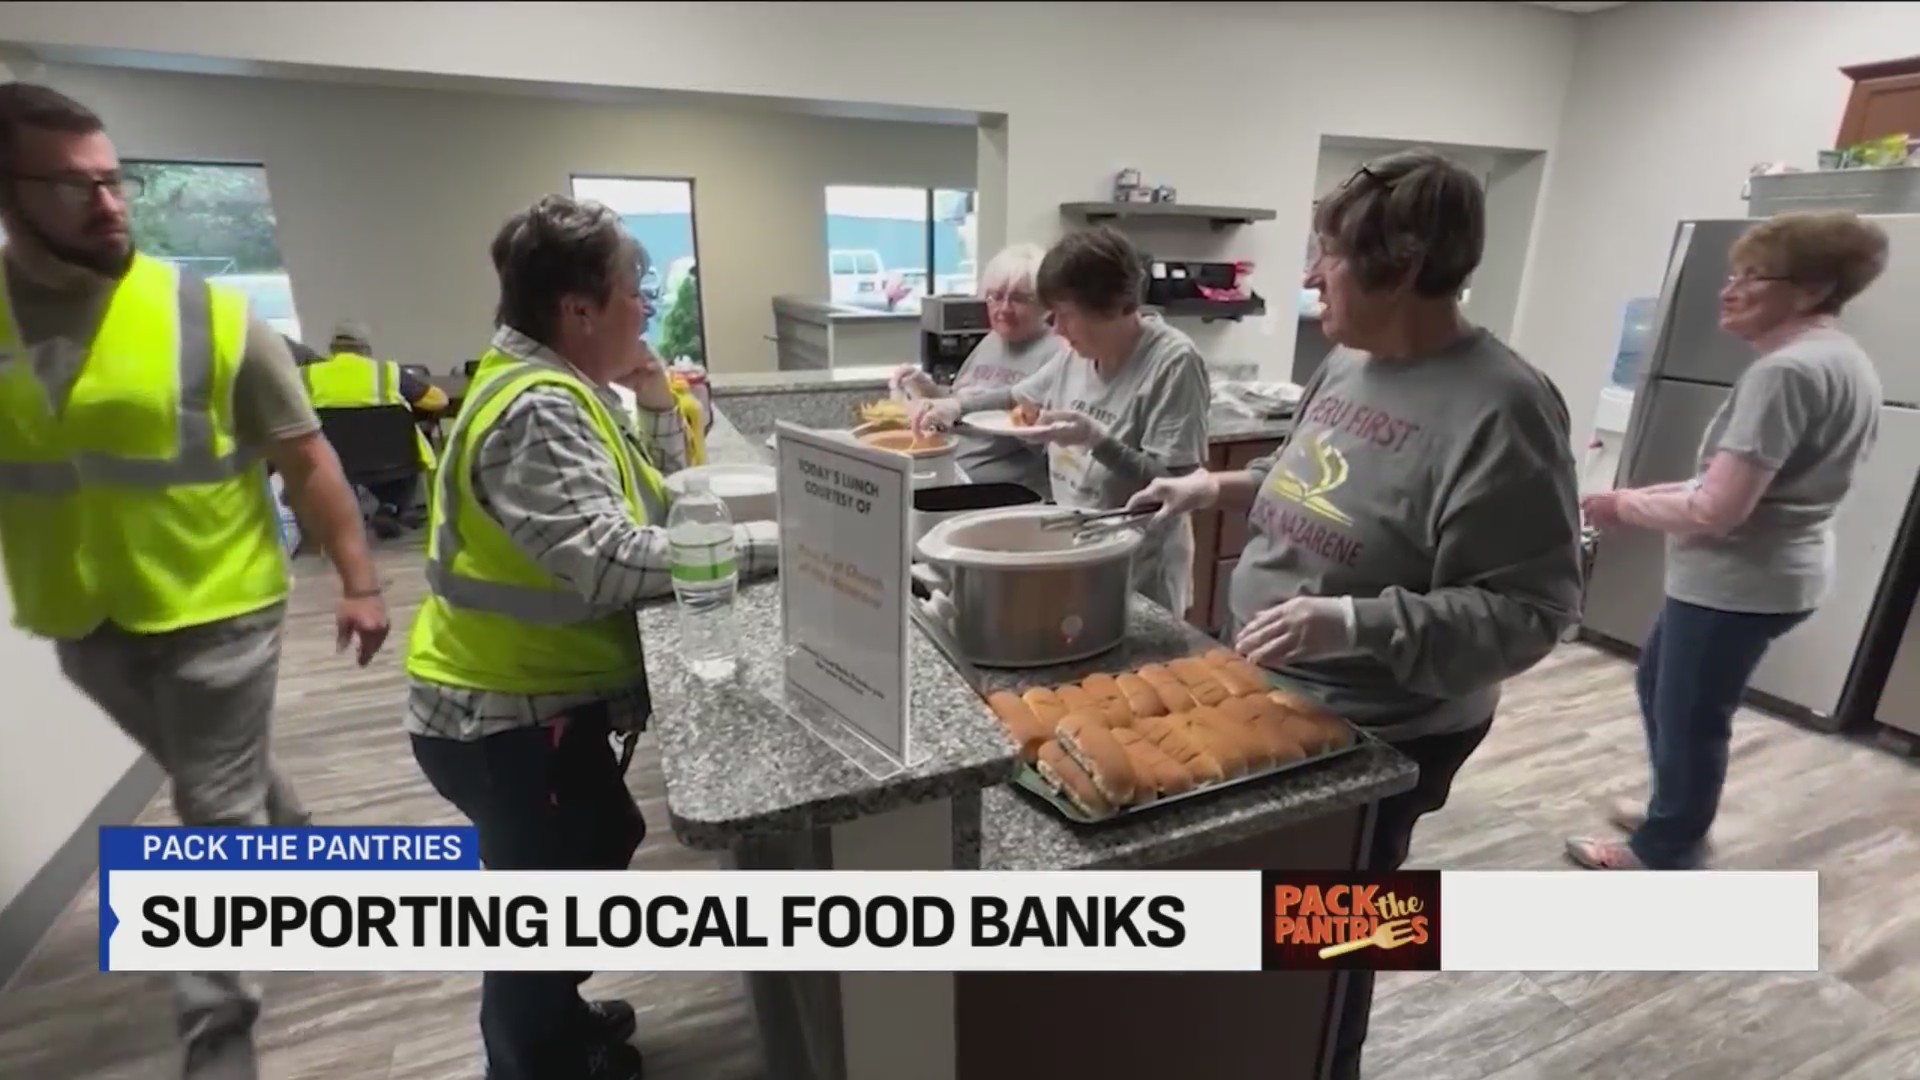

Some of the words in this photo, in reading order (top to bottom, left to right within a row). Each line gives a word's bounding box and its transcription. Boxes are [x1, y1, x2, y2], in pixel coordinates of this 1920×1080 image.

[1344, 405, 1420, 453] FIRST
[804, 480, 854, 509] COURTESY
[856, 498, 872, 515] OF
[842, 473, 879, 498] LUNCH
[1280, 508, 1364, 568] NAZARENE
